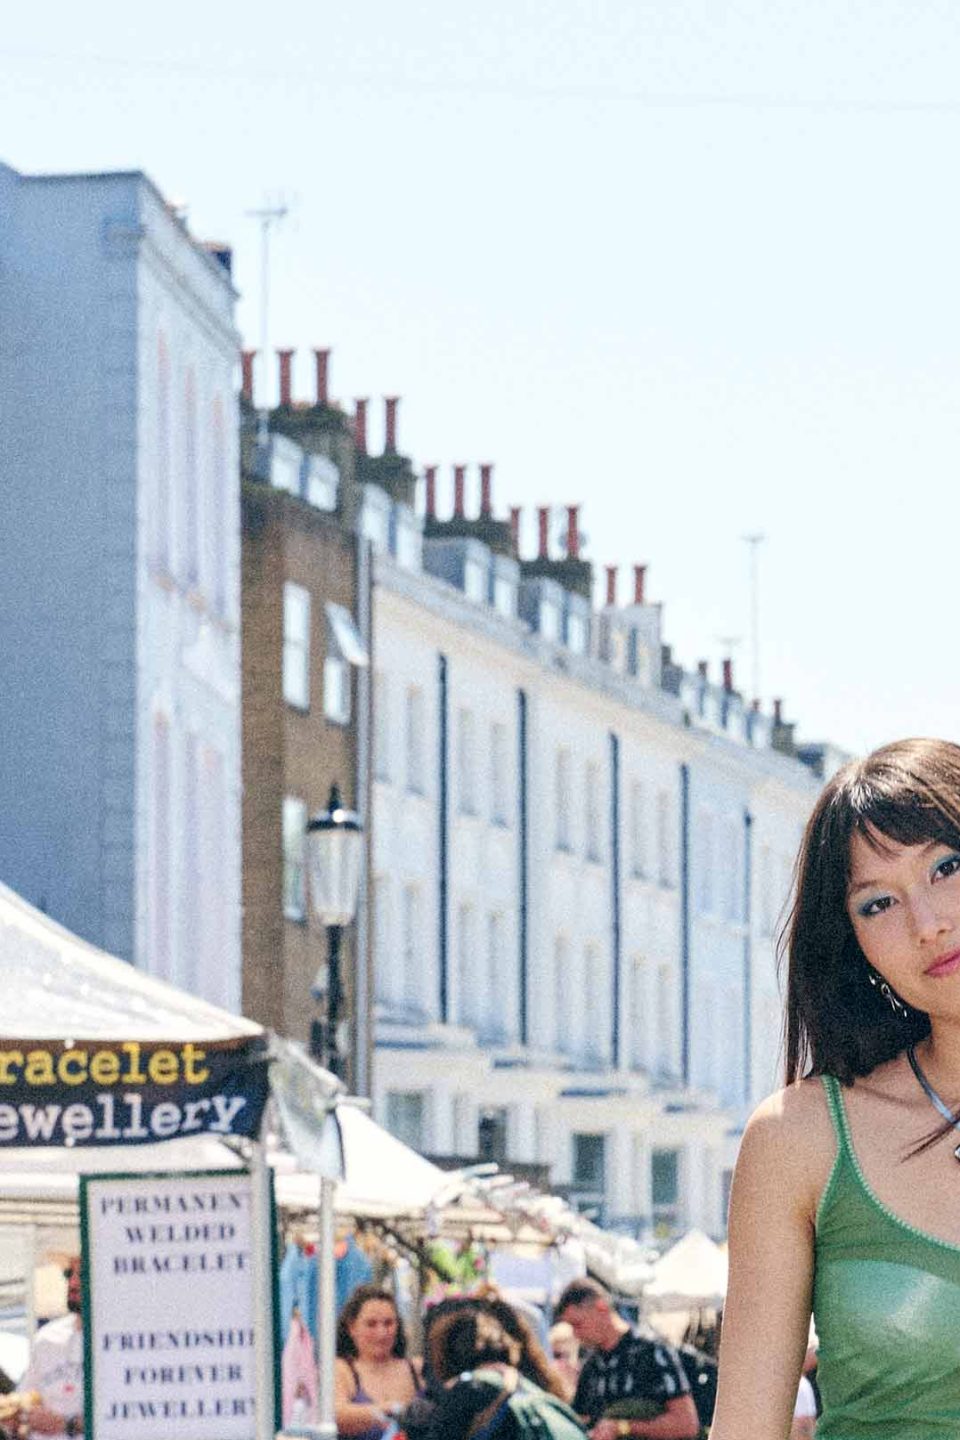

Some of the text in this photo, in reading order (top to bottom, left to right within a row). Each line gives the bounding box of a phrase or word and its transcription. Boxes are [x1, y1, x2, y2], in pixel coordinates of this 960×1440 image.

[102, 1193, 250, 1214] PERMANEN
[126, 1223, 235, 1243] WELDED
[114, 1252, 247, 1274] BRACELET
[124, 1365, 242, 1384] FOREVER
[107, 1397, 255, 1418] JEWELLER
